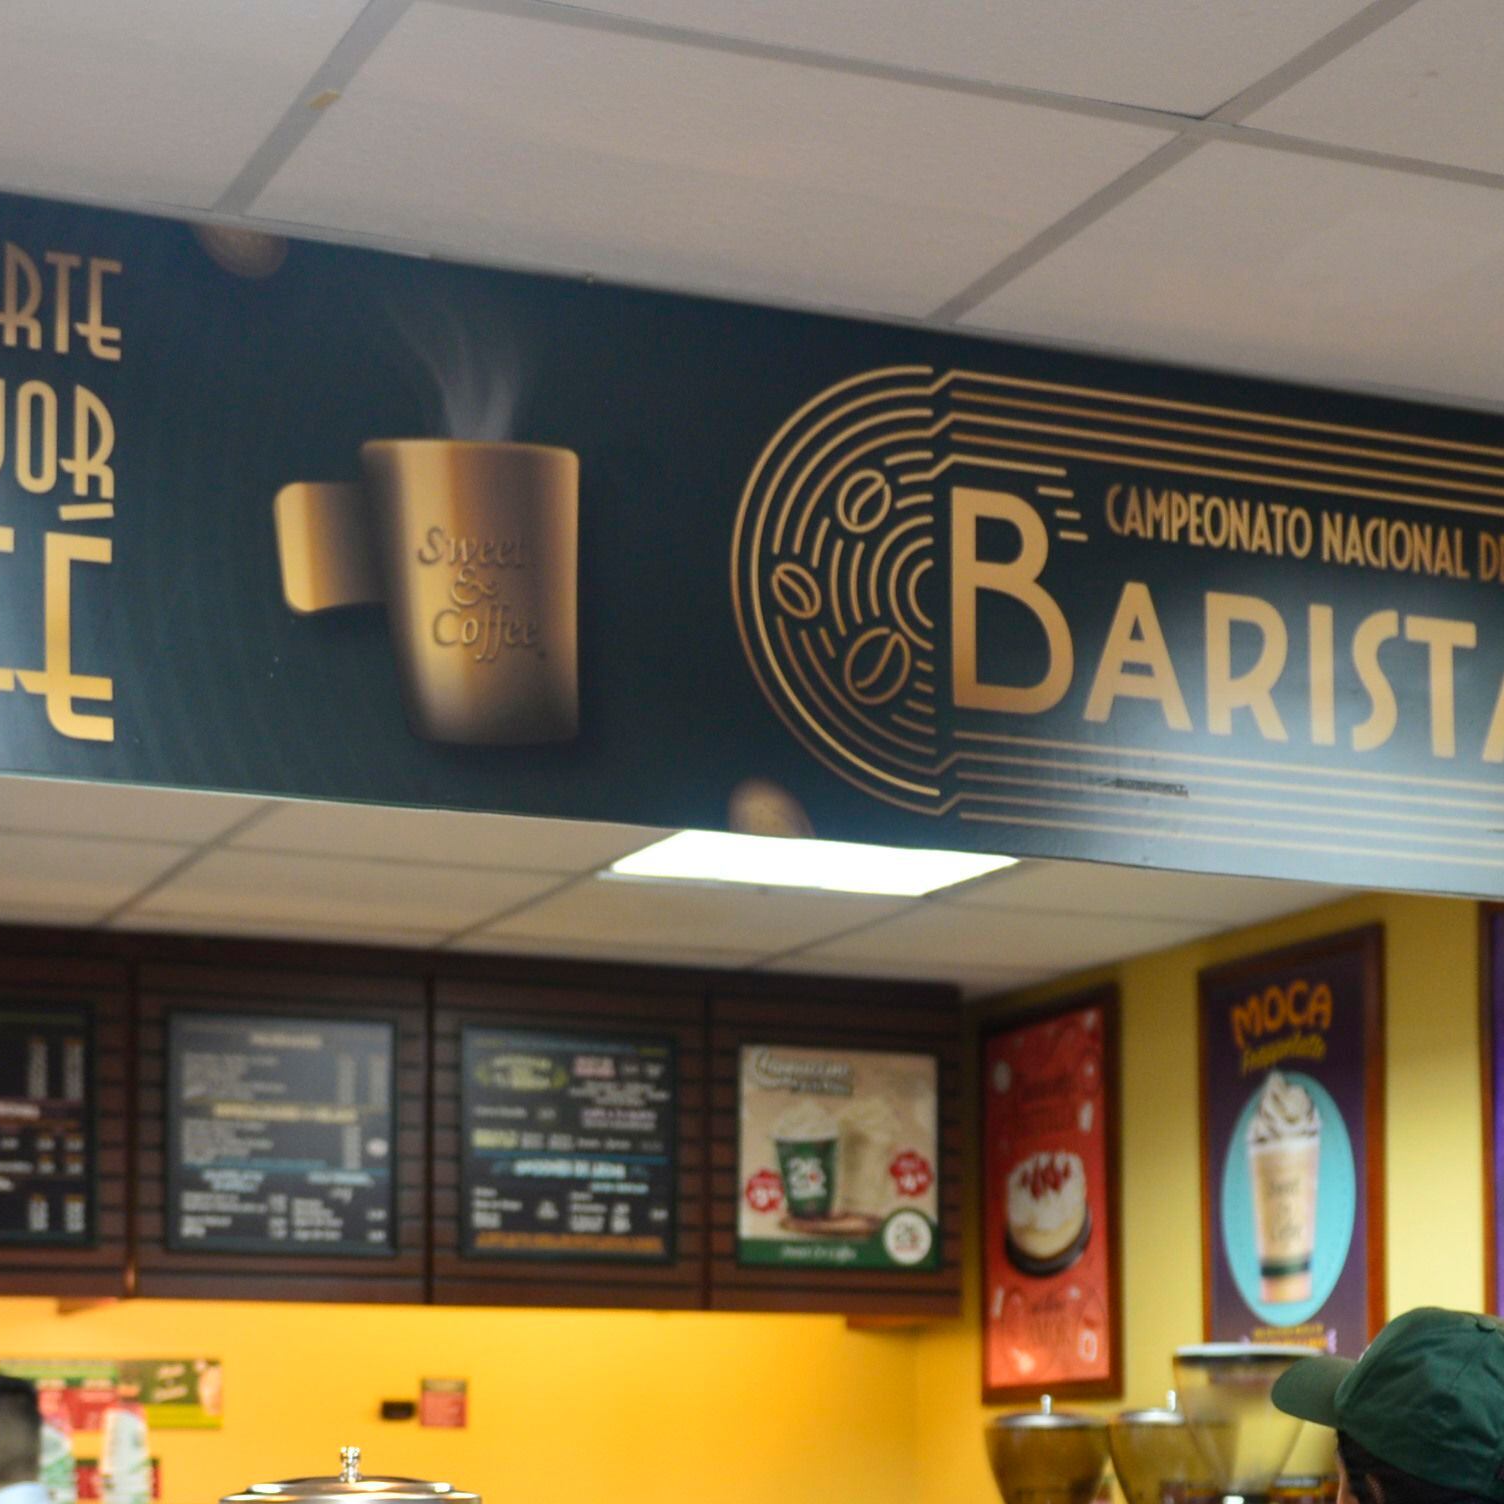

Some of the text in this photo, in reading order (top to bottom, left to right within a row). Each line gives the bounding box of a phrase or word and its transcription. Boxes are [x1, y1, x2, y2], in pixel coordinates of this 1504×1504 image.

[417, 525, 526, 568] Sweet
[1106, 483, 1313, 559] CAMPEONATO
[1322, 512, 1471, 581] NACIONAL
[450, 566, 498, 607] &
[432, 604, 538, 662] Coffee
[1231, 979, 1333, 1051] MOCA
